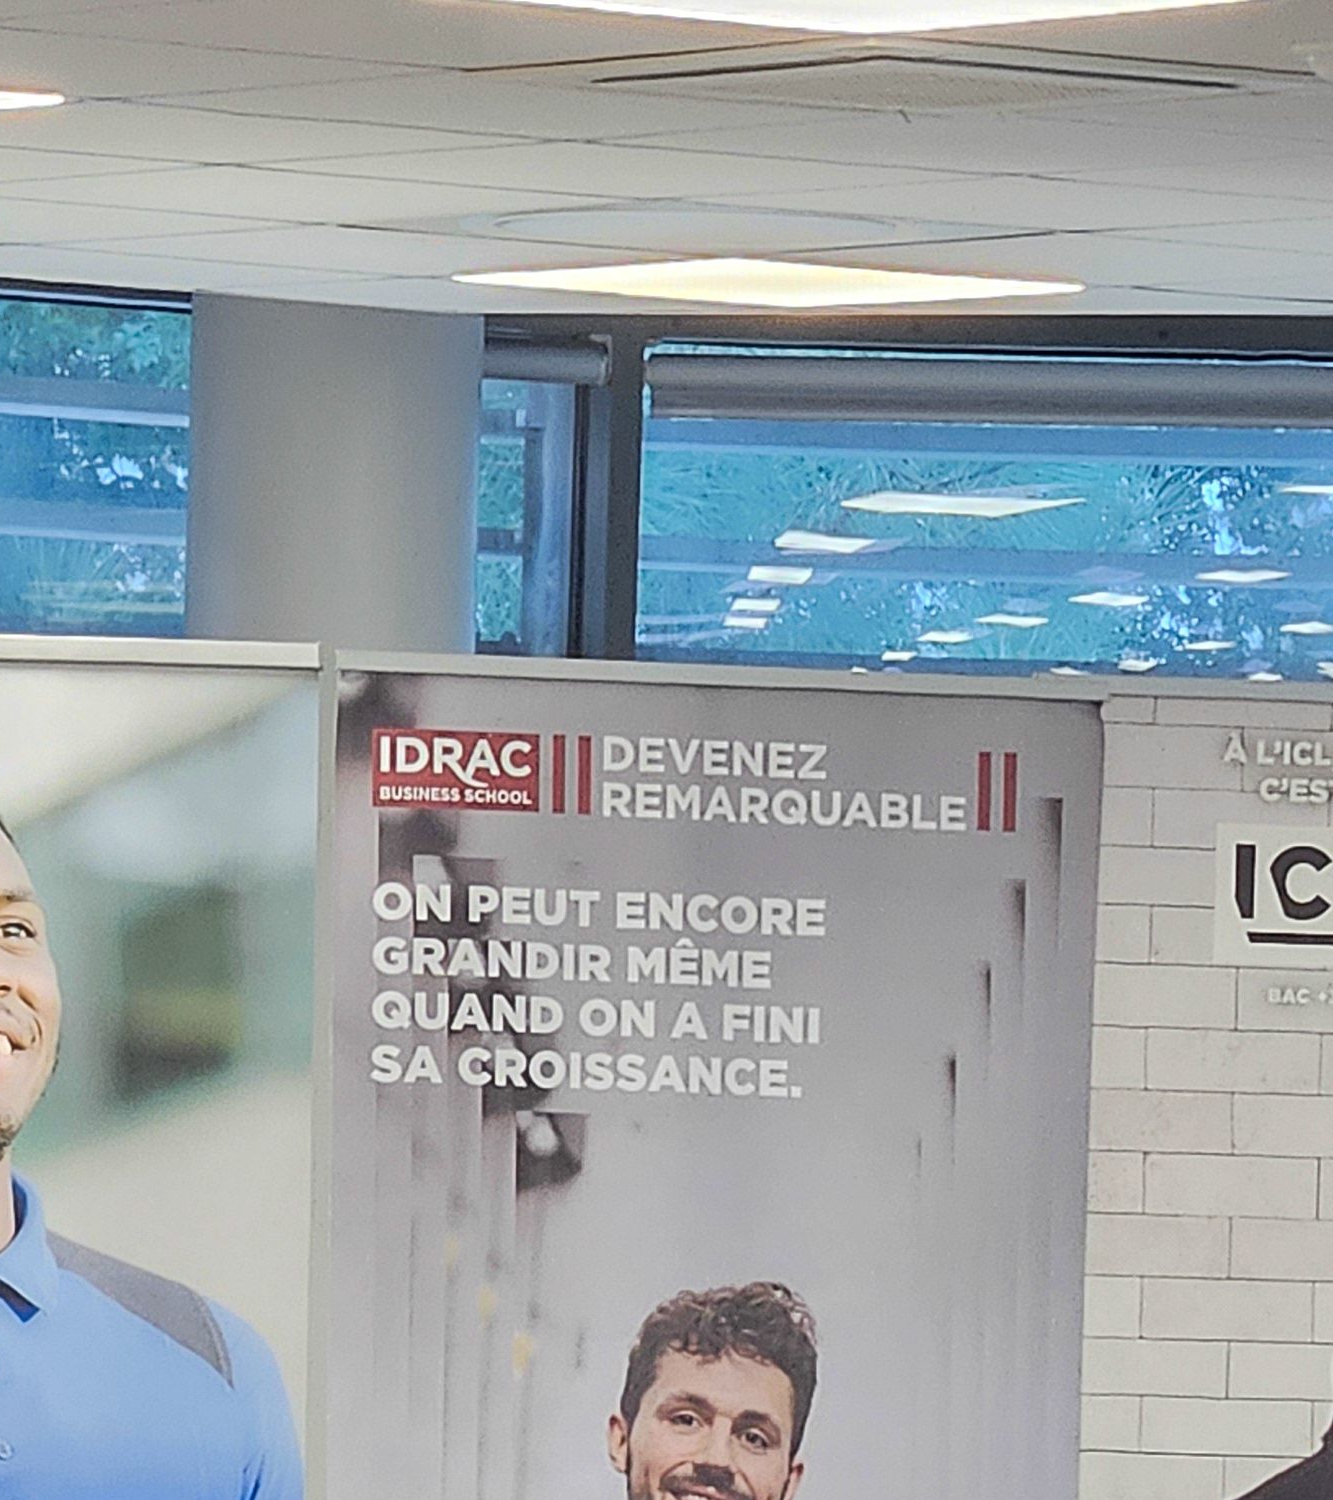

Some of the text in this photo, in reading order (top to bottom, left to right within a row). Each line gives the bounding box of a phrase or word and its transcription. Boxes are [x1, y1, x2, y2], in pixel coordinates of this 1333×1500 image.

[379, 735, 532, 788] IDRAC
[602, 735, 828, 781] DEVENEZ
[379, 785, 533, 806] BUSINESS SCHOOL
[601, 782, 967, 833] REMARQUABLE
[1259, 777, 1333, 804] C'ES
[372, 881, 827, 937] ON PEUT ENCORE
[371, 937, 772, 990] GRANDIR MÊME
[370, 990, 820, 1045] QUAND ON A FINI
[370, 1044, 802, 1099] SA CROISSANCE.
